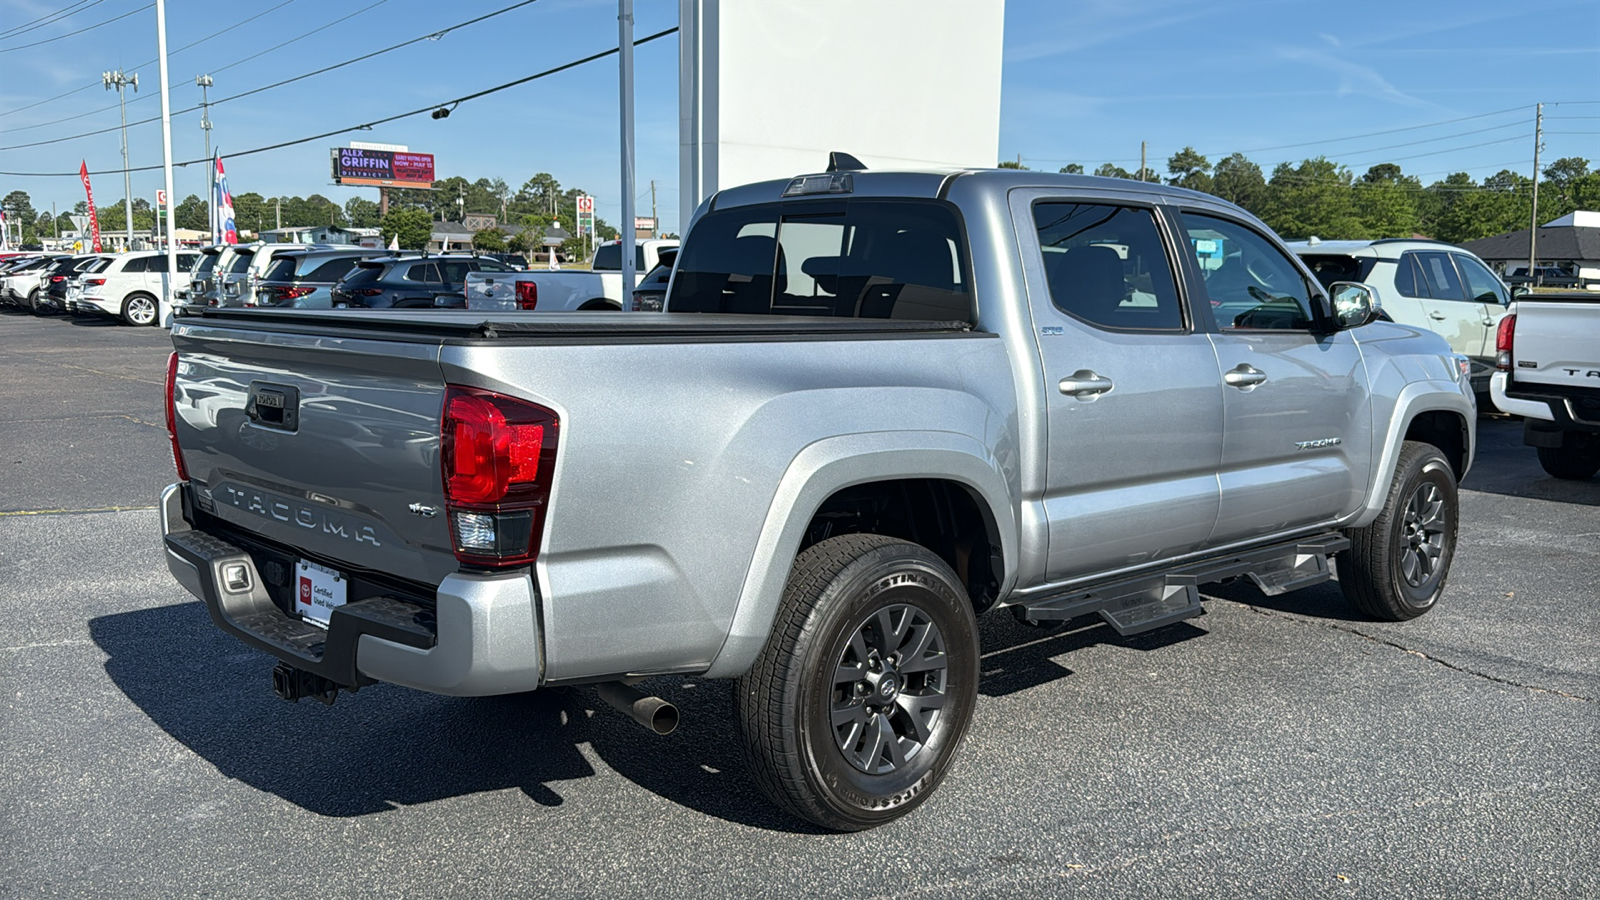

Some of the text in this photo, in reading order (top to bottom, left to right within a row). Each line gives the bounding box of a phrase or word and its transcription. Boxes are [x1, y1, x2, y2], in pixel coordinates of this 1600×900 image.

[342, 149, 364, 157] ALEX
[342, 157, 389, 168] GRIFFIN
[1294, 437, 1342, 451] TACOMA
[226, 486, 381, 546] TACOMA
[313, 585, 333, 598] Certified
[313, 596, 325, 607] Used
